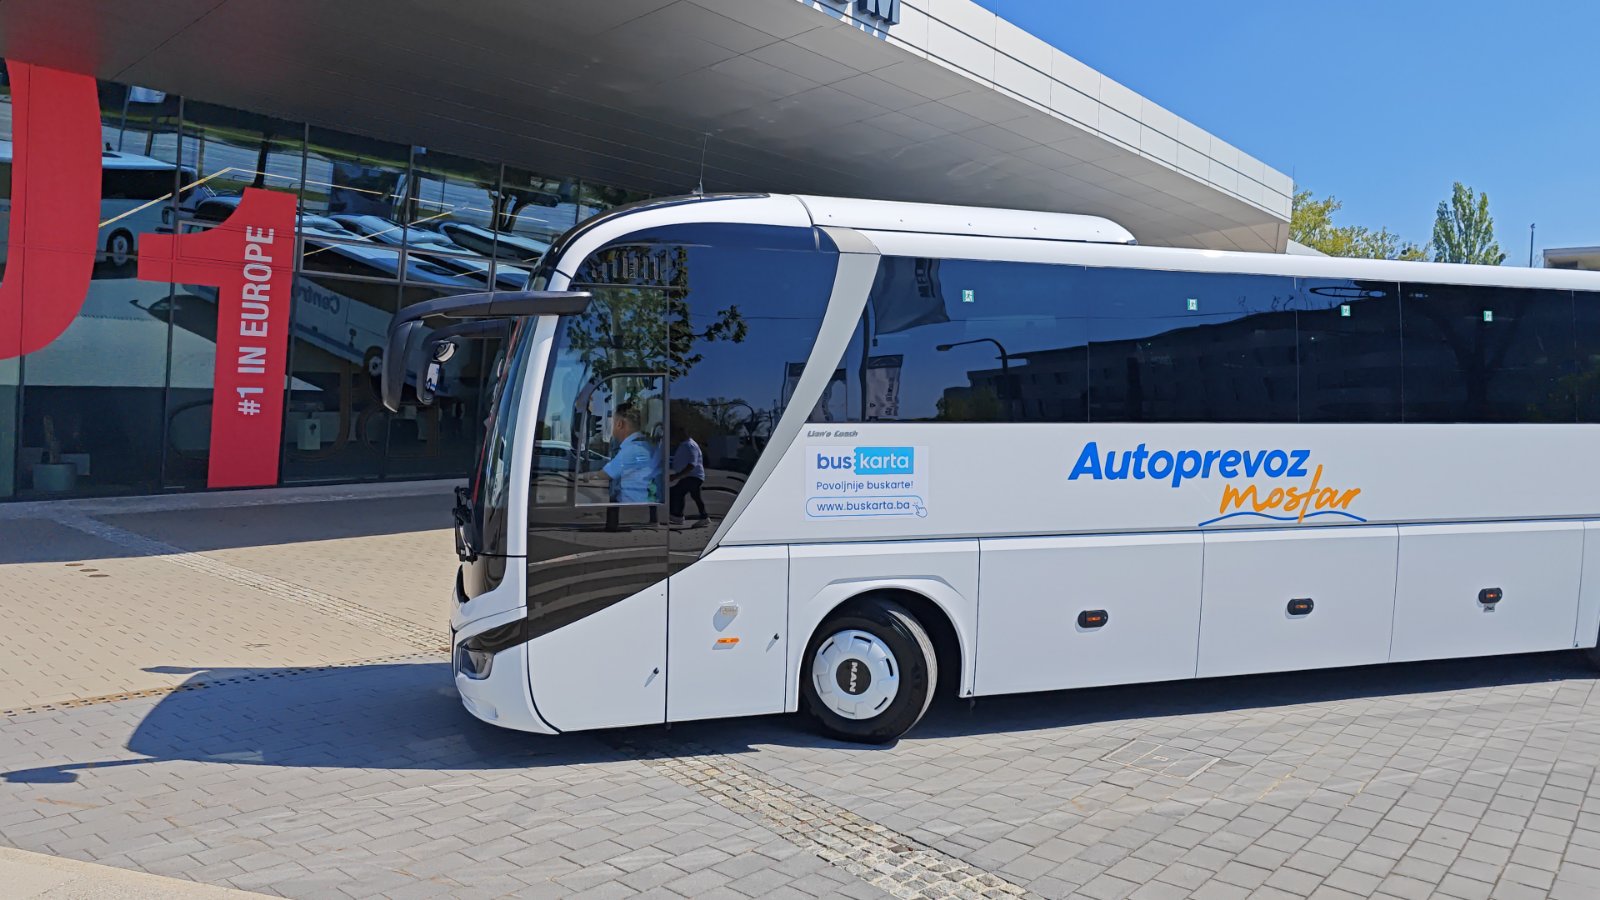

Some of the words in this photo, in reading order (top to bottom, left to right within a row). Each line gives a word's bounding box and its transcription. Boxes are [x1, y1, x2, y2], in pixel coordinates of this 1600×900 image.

[240, 226, 274, 337] EUROPE
[238, 347, 267, 373] IN
[237, 387, 263, 415] #1
[1068, 442, 1310, 488] Autoprevoz
[816, 481, 864, 493] Povoljnije
[866, 480, 914, 490] buskarte!
[816, 501, 910, 512] www.buskarta.ba
[849, 661, 858, 693] MAN
